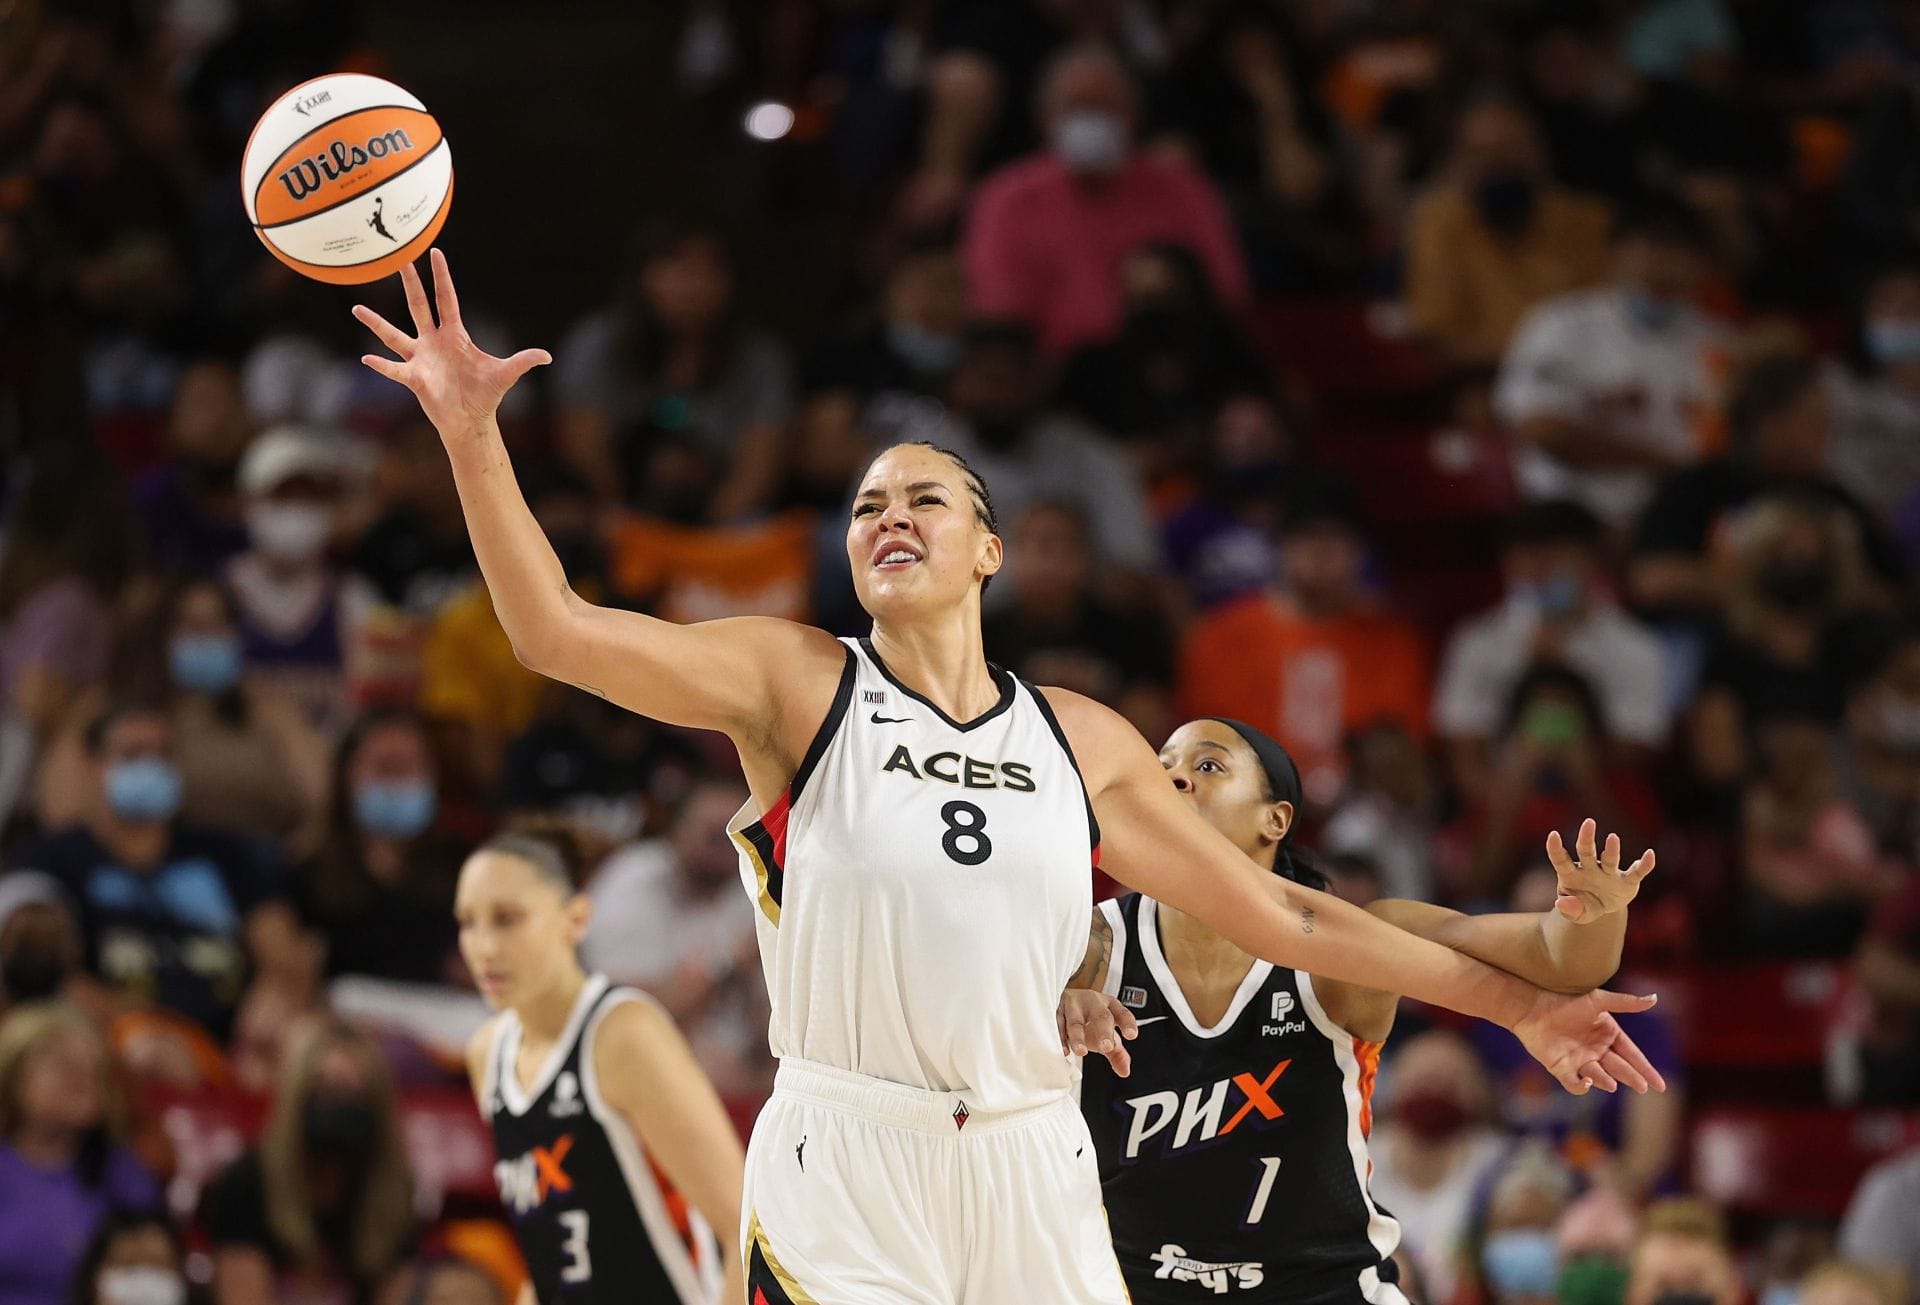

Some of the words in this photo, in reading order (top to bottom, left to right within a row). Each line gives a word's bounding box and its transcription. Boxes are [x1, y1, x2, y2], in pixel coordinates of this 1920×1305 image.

[278, 128, 413, 201] Wilson
[881, 743, 1038, 794] ACES
[941, 800, 992, 866] 8
[1261, 1021, 1305, 1037] PayPal
[1125, 1059, 1292, 1158] PHX
[1246, 1157, 1282, 1224] 1
[558, 1209, 592, 1283] 3
